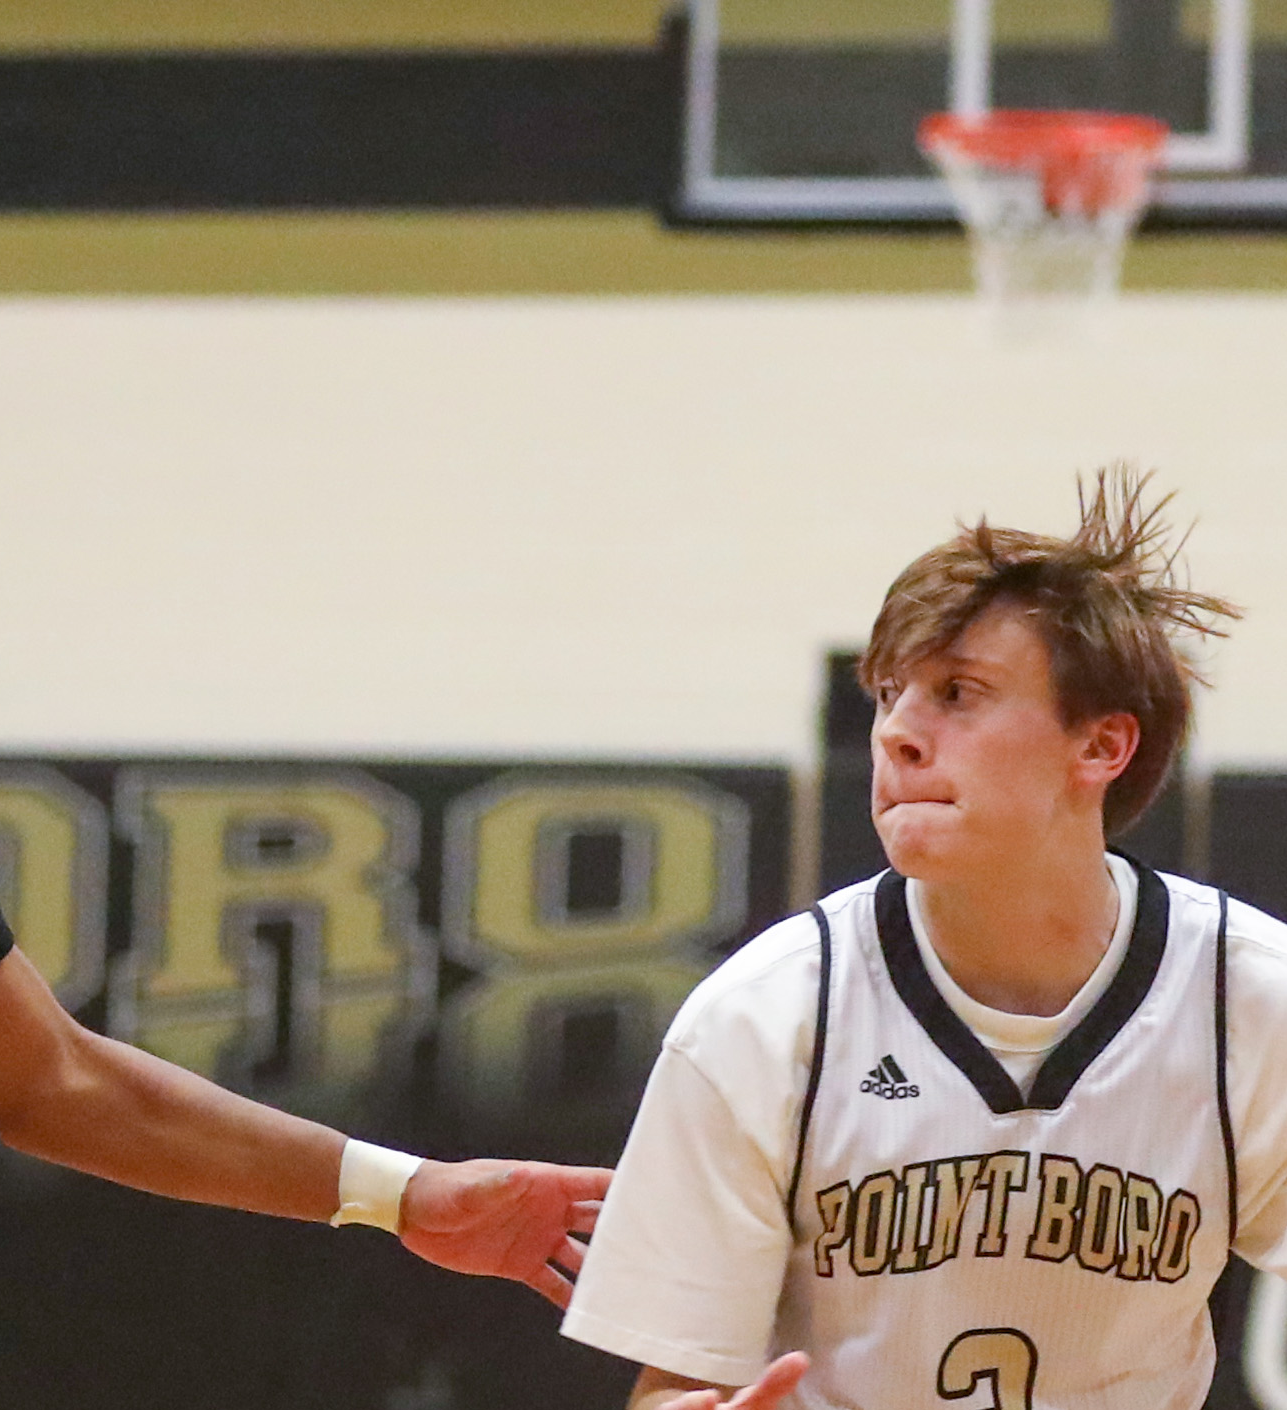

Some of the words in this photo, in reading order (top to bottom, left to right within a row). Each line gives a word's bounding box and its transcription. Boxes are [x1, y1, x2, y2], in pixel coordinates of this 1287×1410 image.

[859, 1079, 921, 1100] addas
[815, 1149, 1030, 1279] POINT
[1026, 1152, 1201, 1284] BORO
